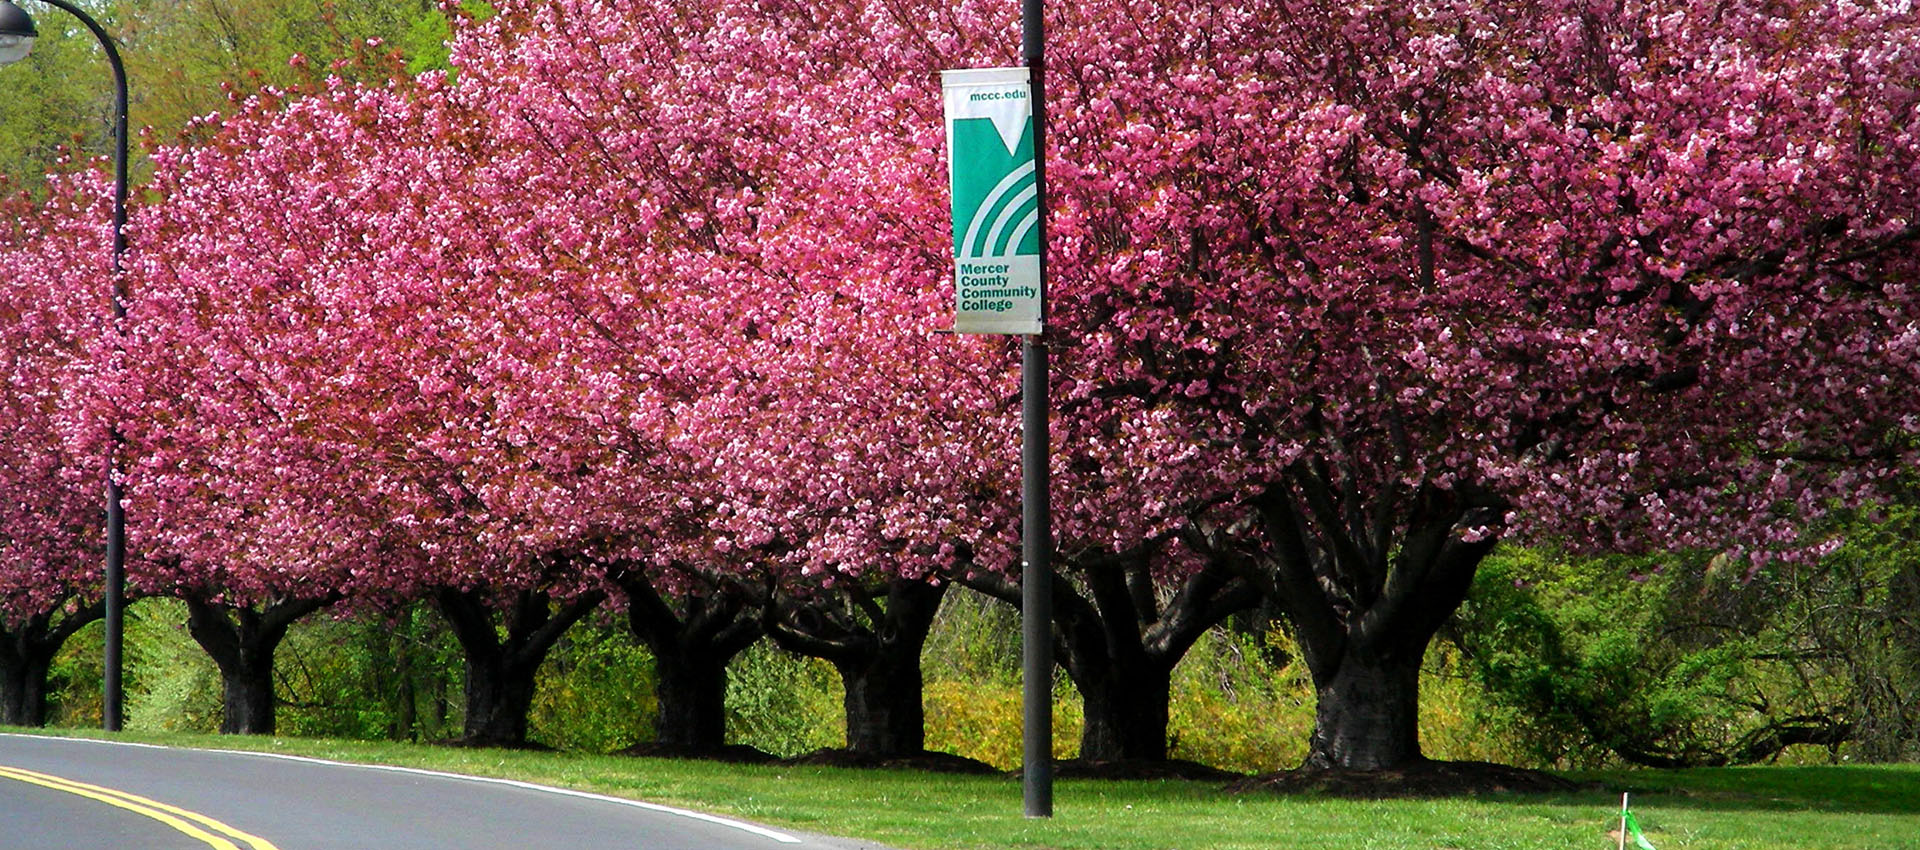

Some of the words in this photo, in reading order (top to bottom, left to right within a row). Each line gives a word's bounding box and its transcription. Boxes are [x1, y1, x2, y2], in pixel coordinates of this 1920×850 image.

[970, 89, 1026, 101] mccc.edu
[961, 264, 1010, 275] Mercer
[961, 276, 1009, 287] County
[961, 286, 1037, 299] Community
[962, 300, 1013, 312] College
